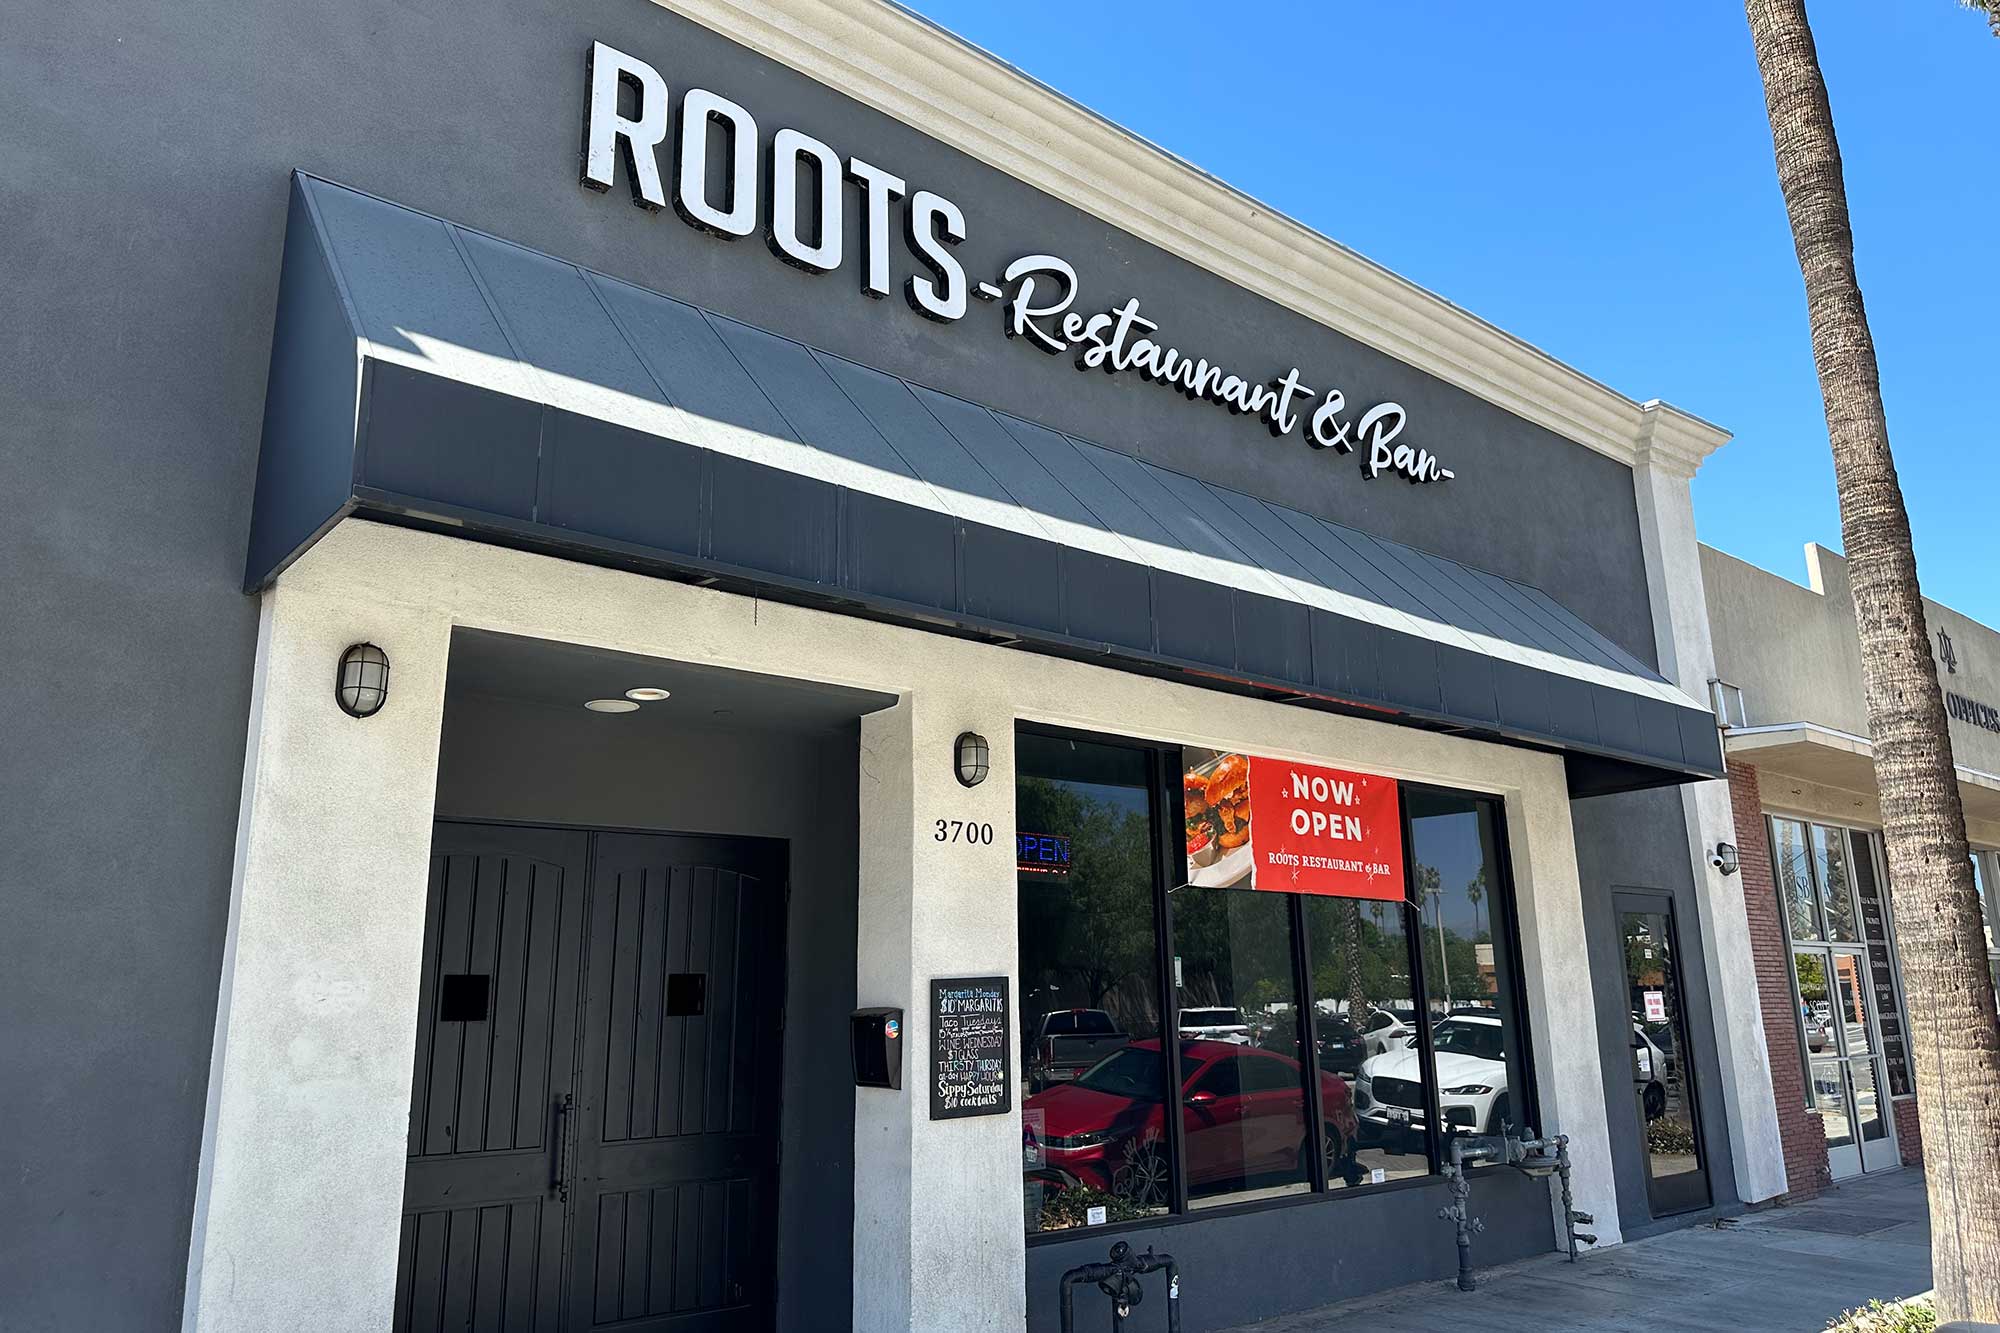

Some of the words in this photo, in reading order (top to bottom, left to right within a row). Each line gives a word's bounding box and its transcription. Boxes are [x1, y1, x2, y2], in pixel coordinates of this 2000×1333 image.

[583, 40, 967, 321] ROOTS
[1310, 389, 1353, 453] &
[1946, 692, 2000, 733] OFFICES
[1291, 773, 1354, 807] NOW
[934, 819, 994, 845] 3700
[1291, 808, 1363, 842] OPEN
[1268, 852, 1300, 867] ROOTS
[1302, 855, 1364, 873] RESTAURANT
[1373, 864, 1391, 875] BAR
[939, 1014, 959, 1027] Taco
[938, 1038, 961, 1051] WINE
[958, 1049, 979, 1060] GLASS
[938, 1060, 975, 1072] THIRSTY
[938, 1080, 967, 1098] Sippy
[967, 1080, 1004, 1097] Saturday
